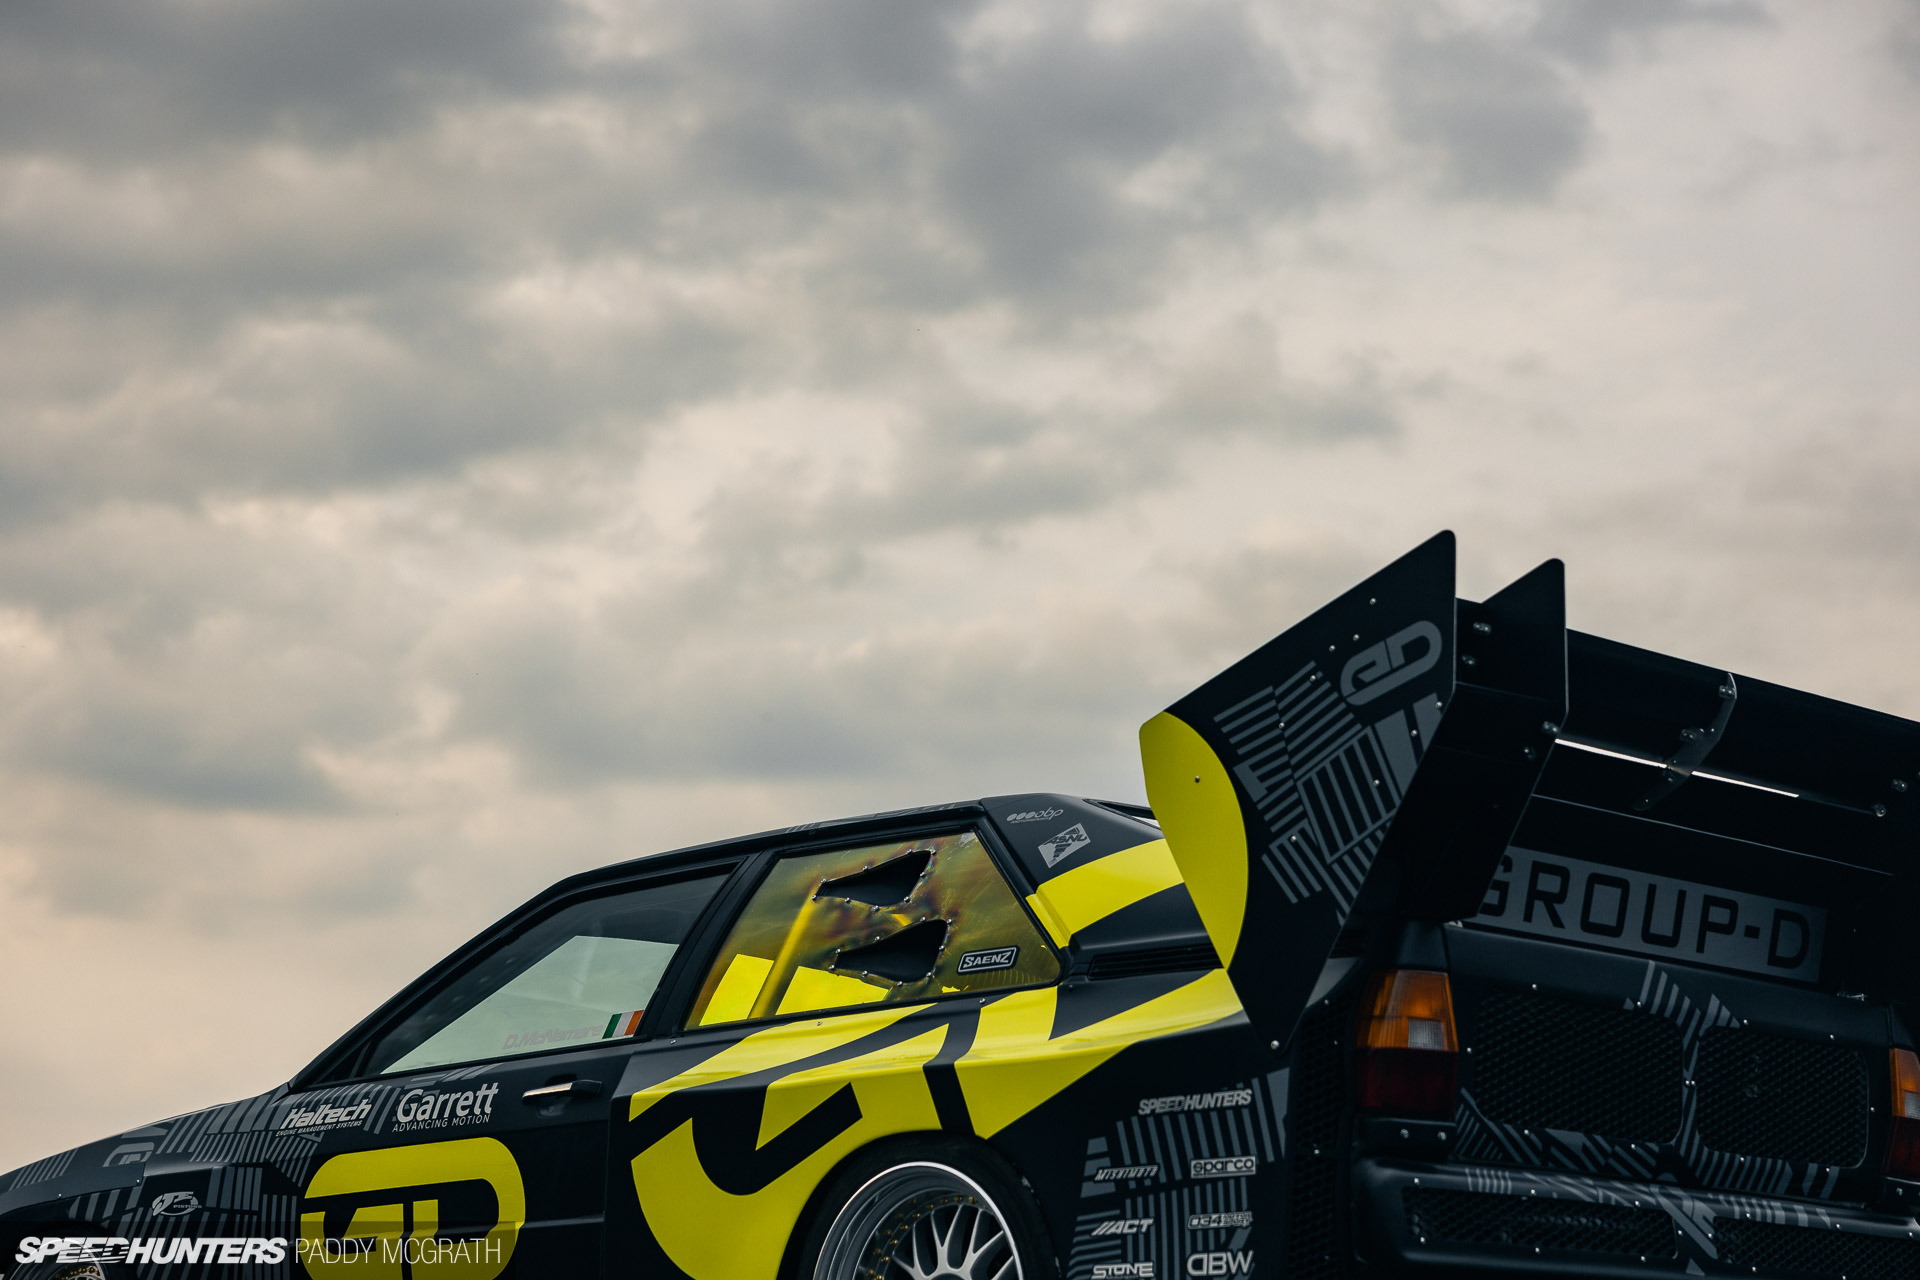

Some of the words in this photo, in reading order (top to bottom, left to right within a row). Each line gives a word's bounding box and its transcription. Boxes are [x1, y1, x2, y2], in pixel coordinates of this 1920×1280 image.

[962, 951, 1010, 968] SAENZ
[396, 1082, 499, 1123] Garrett
[1138, 1089, 1252, 1115] SPEEDHUNTERS
[280, 1098, 372, 1130] Haltech
[275, 1128, 298, 1137] ENGINE
[297, 1123, 336, 1134] MANAGEMENT
[335, 1120, 363, 1129] SYSTEMS
[392, 1118, 448, 1133] ADVANCING
[451, 1114, 491, 1127] MOTION
[1094, 1165, 1158, 1181] MISHIMOTO
[1091, 1262, 1154, 1279] STONE
